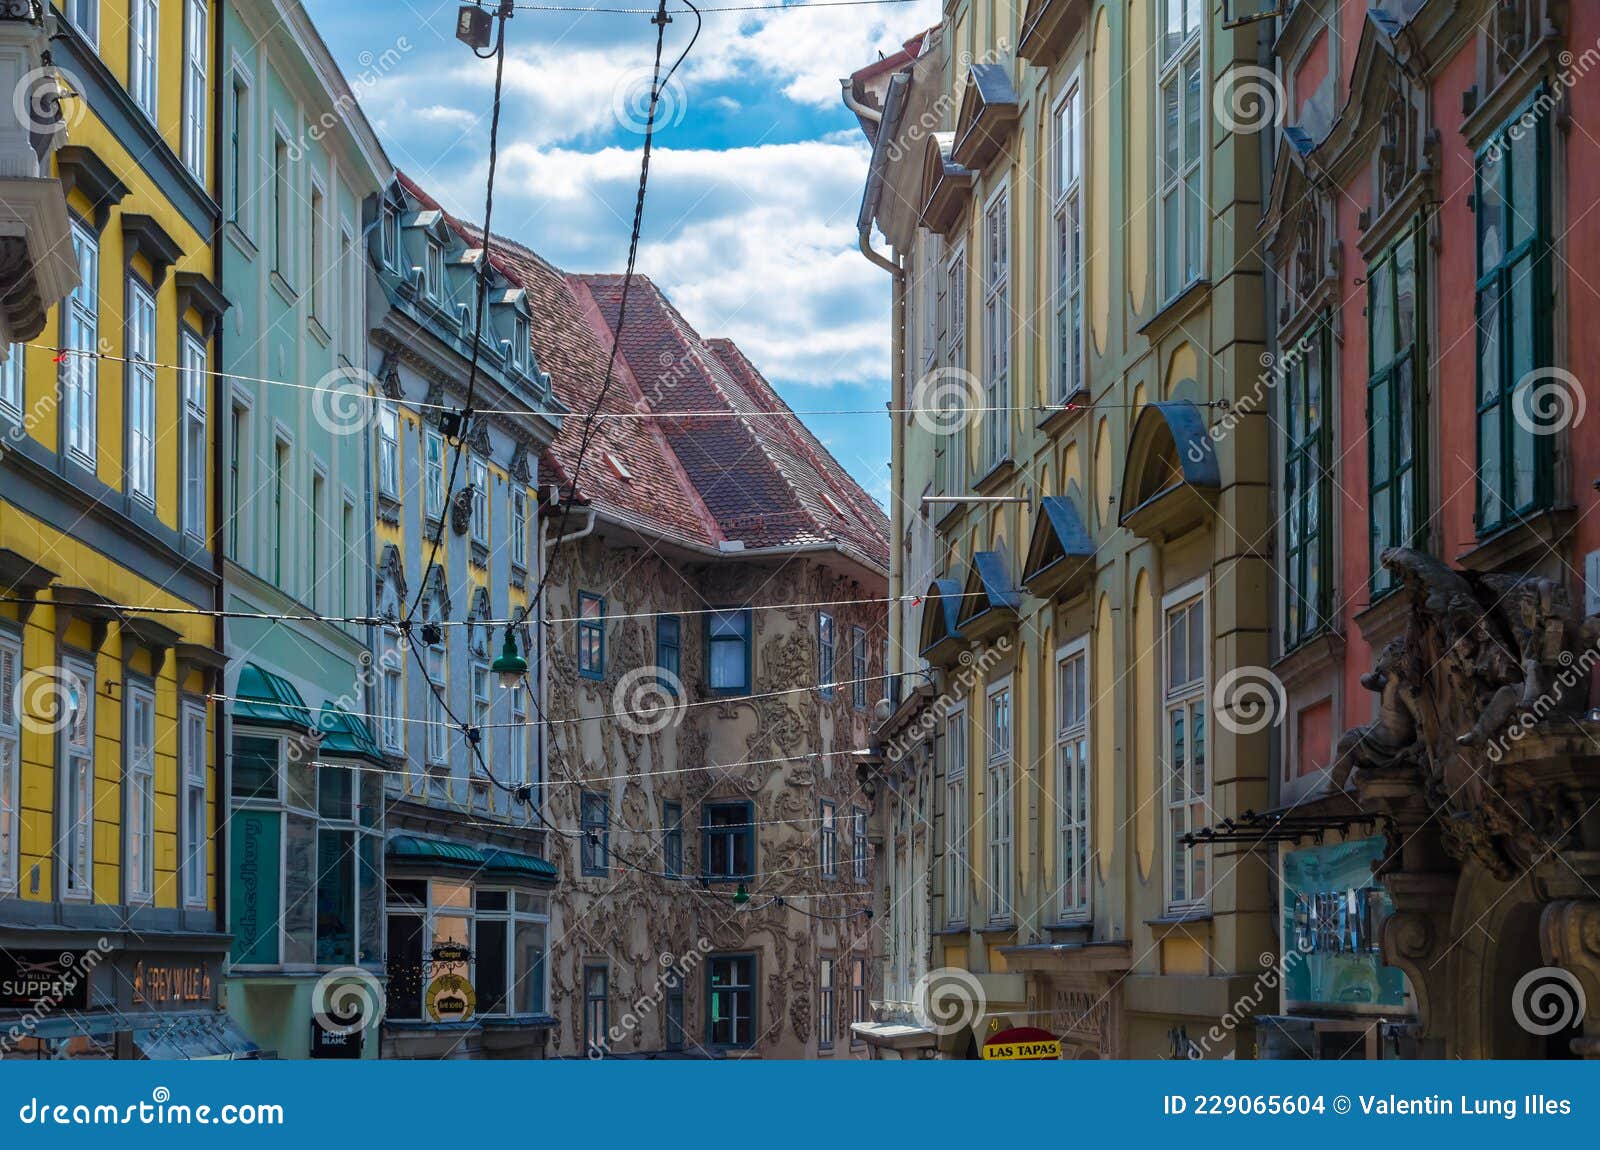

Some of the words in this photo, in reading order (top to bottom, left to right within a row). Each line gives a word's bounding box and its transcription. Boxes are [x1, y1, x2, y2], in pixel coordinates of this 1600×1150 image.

[2, 981, 75, 996] SUPPER
[989, 1046, 1013, 1058] LAS
[1017, 1043, 1057, 1056] TAPAS
